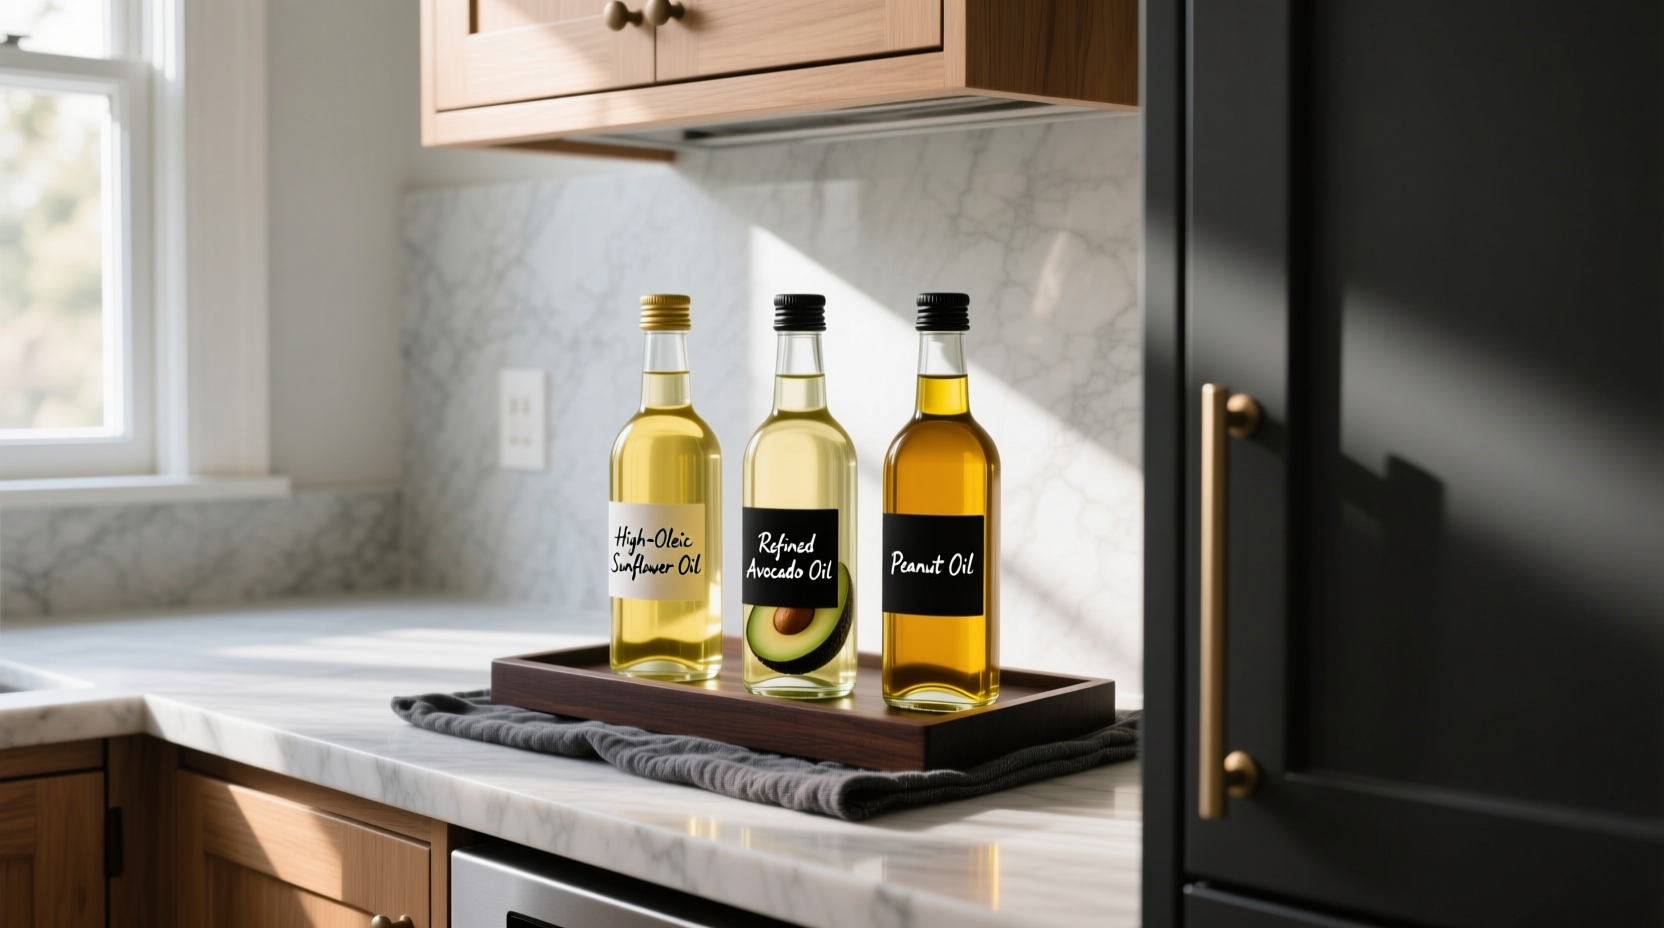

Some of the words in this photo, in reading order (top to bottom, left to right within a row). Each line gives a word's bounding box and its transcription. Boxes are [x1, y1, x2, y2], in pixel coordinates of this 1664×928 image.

[614, 525, 693, 556] High-Oleic
[758, 531, 816, 561] Refined
[611, 552, 674, 581] Sunflower
[678, 553, 702, 575] Oil
[746, 557, 804, 579] Avocado
[808, 559, 832, 580] Oil
[891, 550, 945, 575] Peanut
[948, 552, 975, 576] Oil
